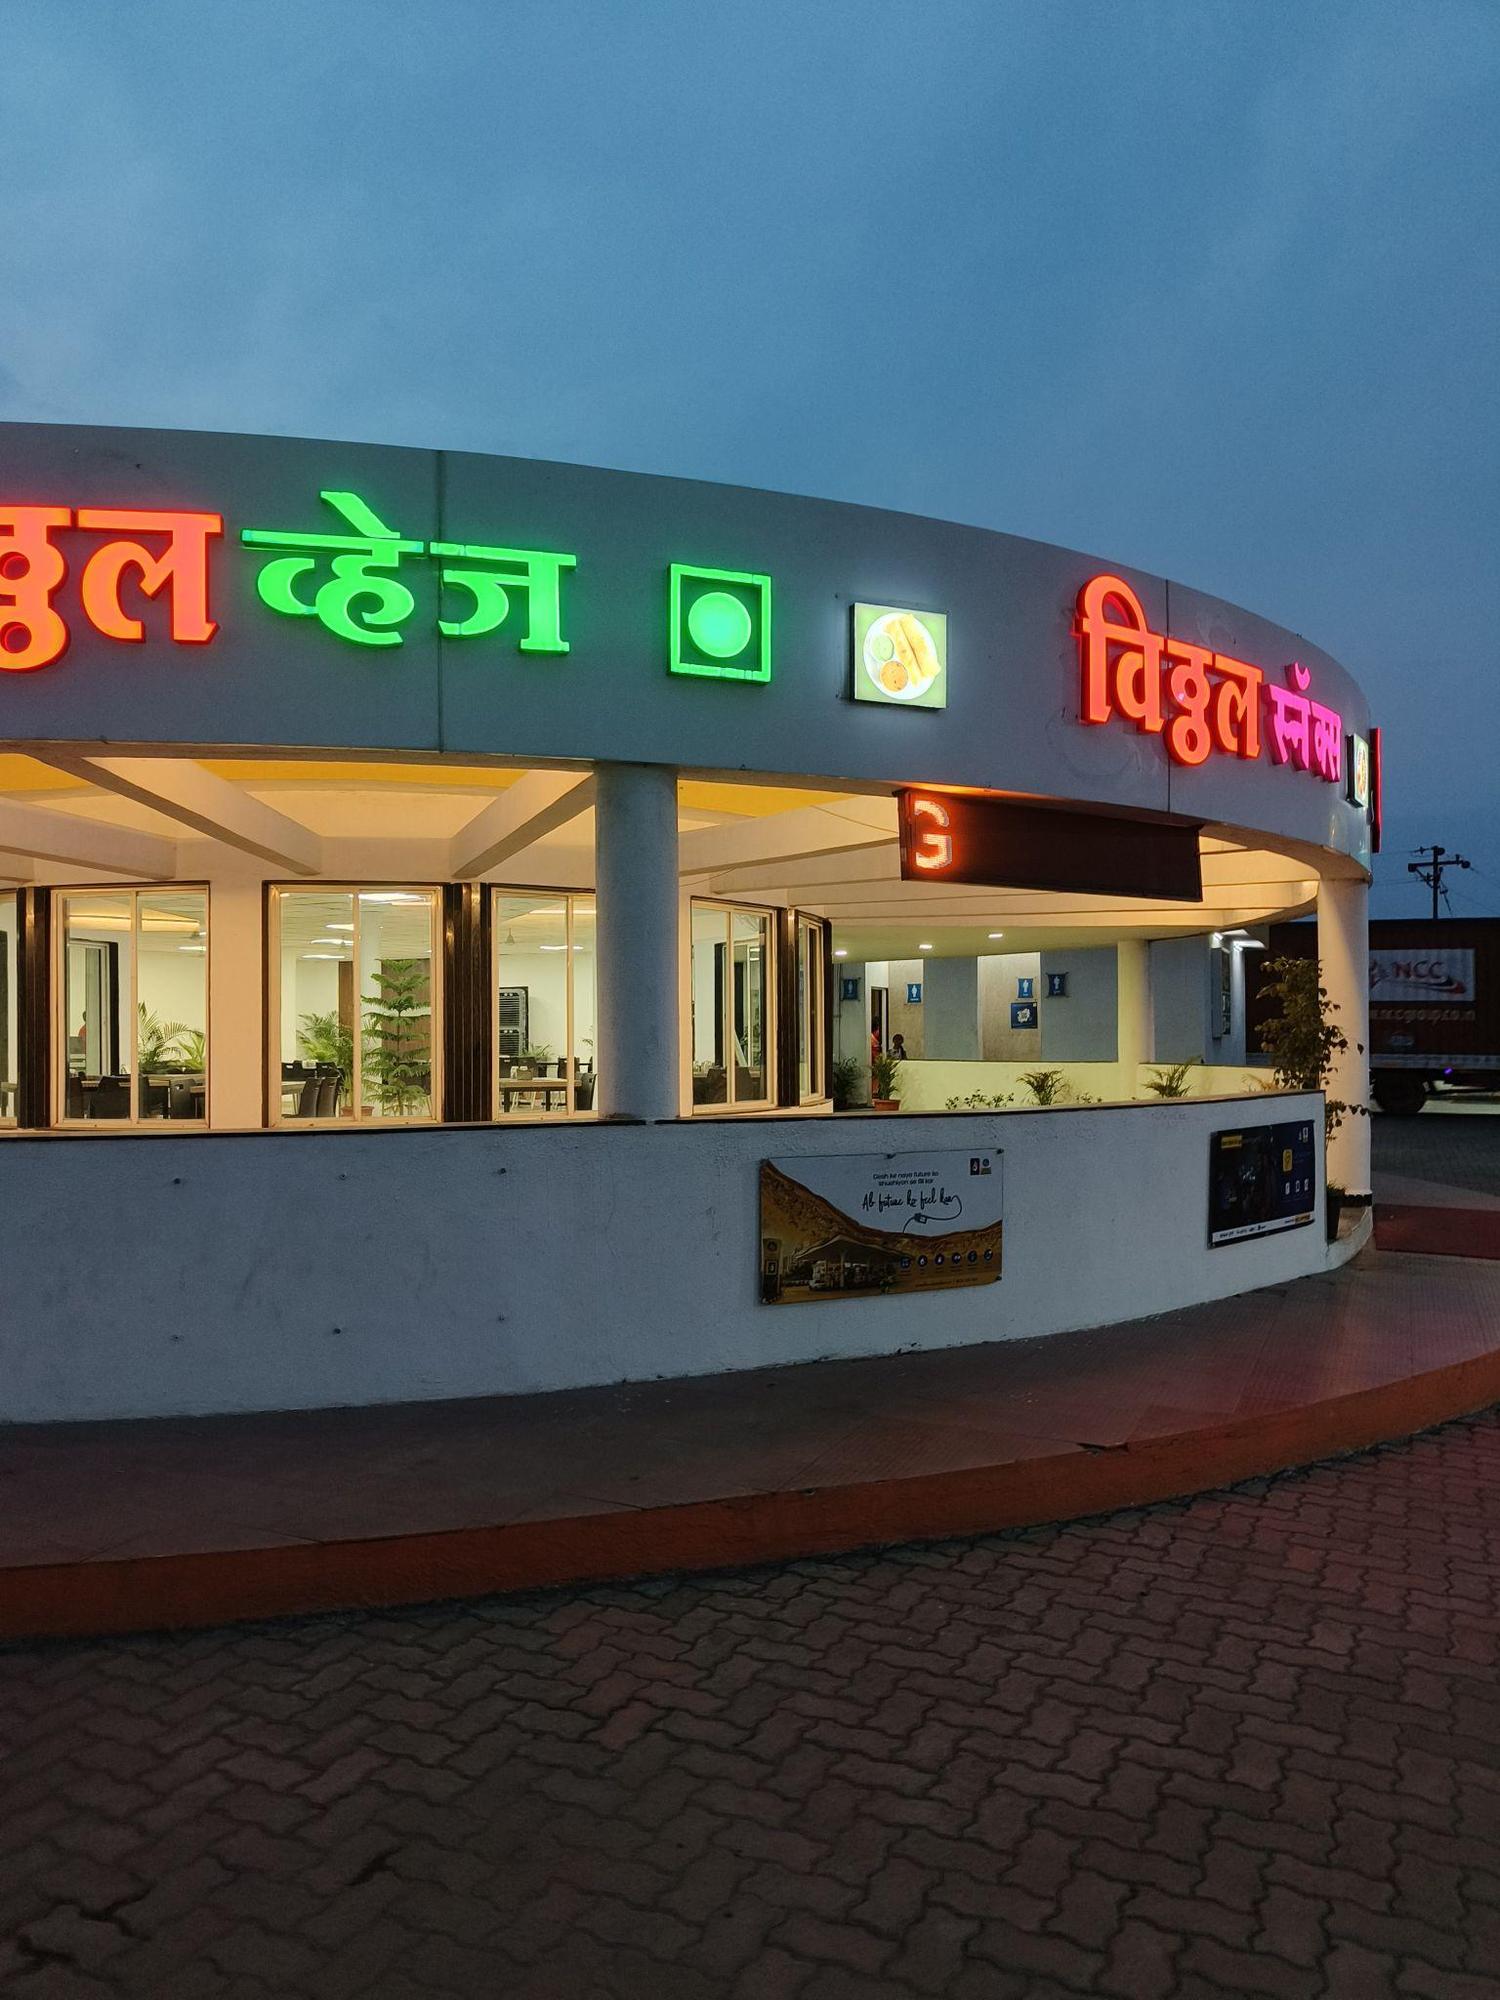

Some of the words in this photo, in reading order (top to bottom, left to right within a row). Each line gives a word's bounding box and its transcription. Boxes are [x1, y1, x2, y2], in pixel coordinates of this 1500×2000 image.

[241, 490, 577, 654] व्हेज
[1074, 573, 1263, 766] विठ्ठल
[862, 1191, 874, 1211] Ab
[878, 1193, 903, 1212] future
[920, 1188, 937, 1209] feel
